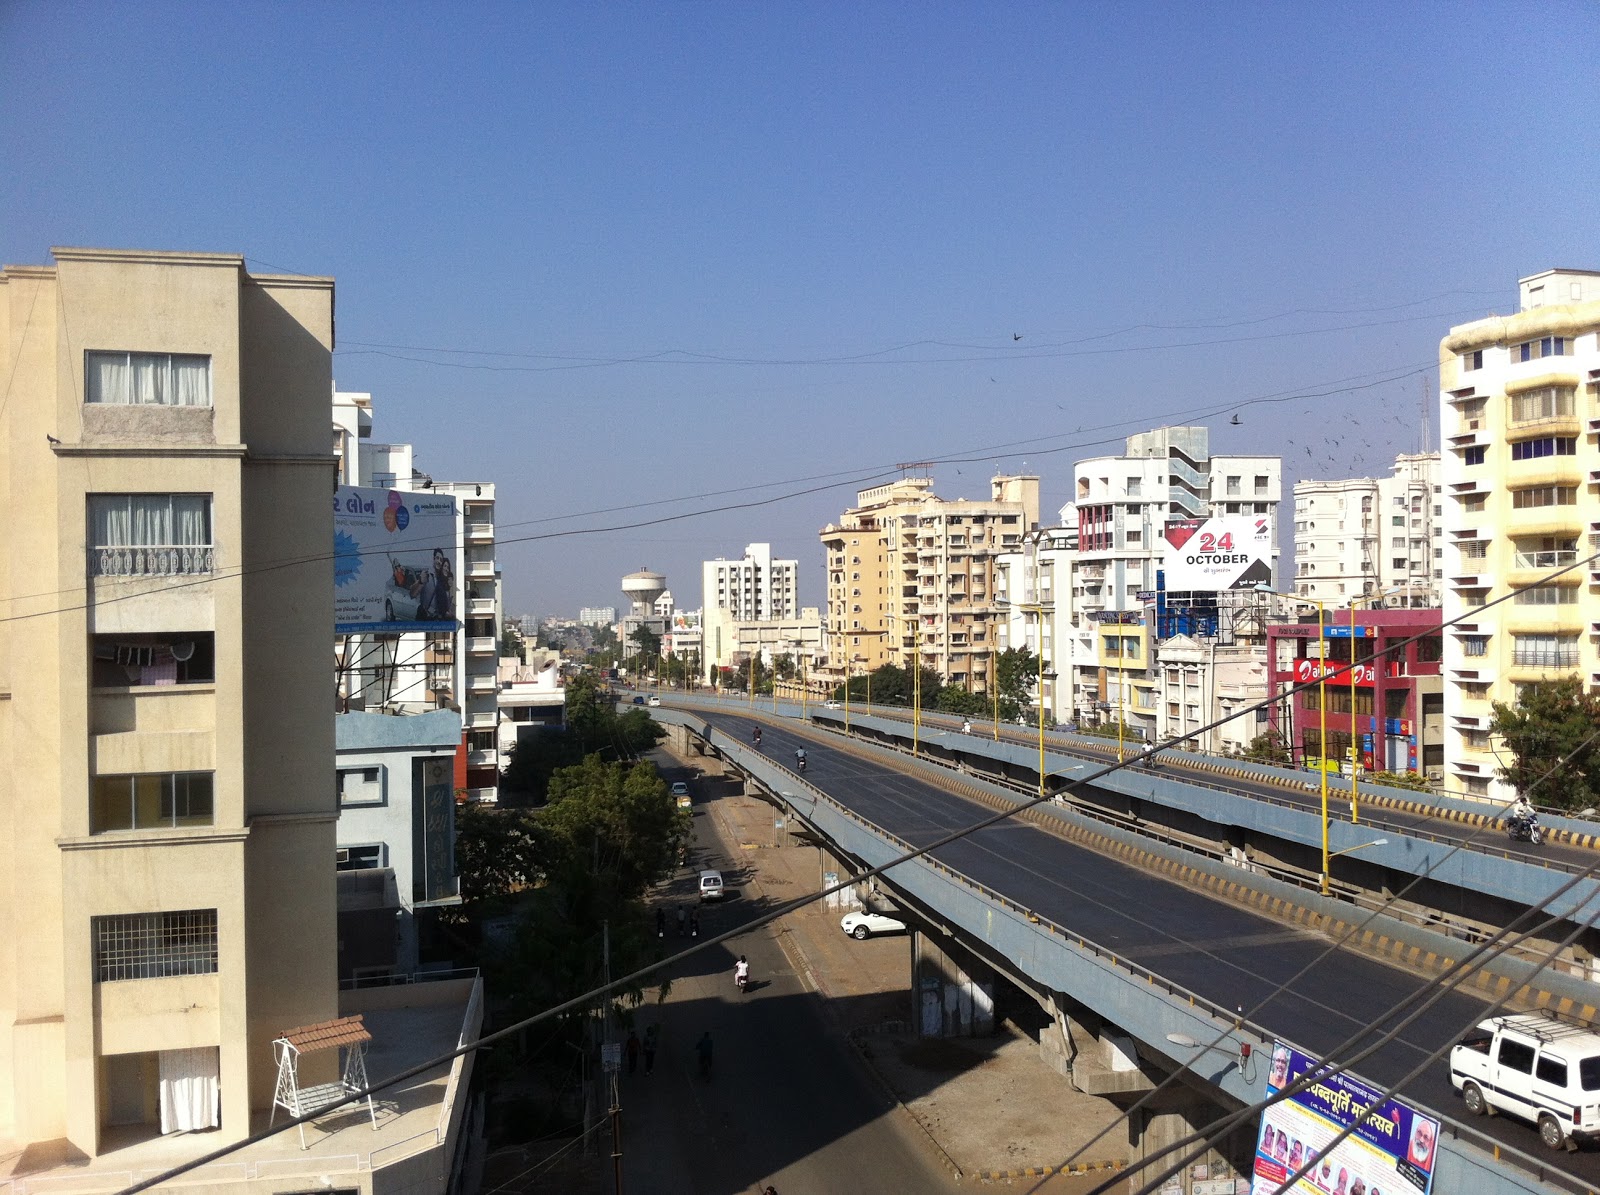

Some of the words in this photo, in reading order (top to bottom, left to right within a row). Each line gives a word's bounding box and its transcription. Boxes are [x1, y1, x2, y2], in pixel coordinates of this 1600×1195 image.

[346, 492, 375, 514] લોન
[1199, 532, 1235, 554] 24
[1186, 554, 1249, 565] OCTOBER
[1312, 665, 1336, 679] aitel
